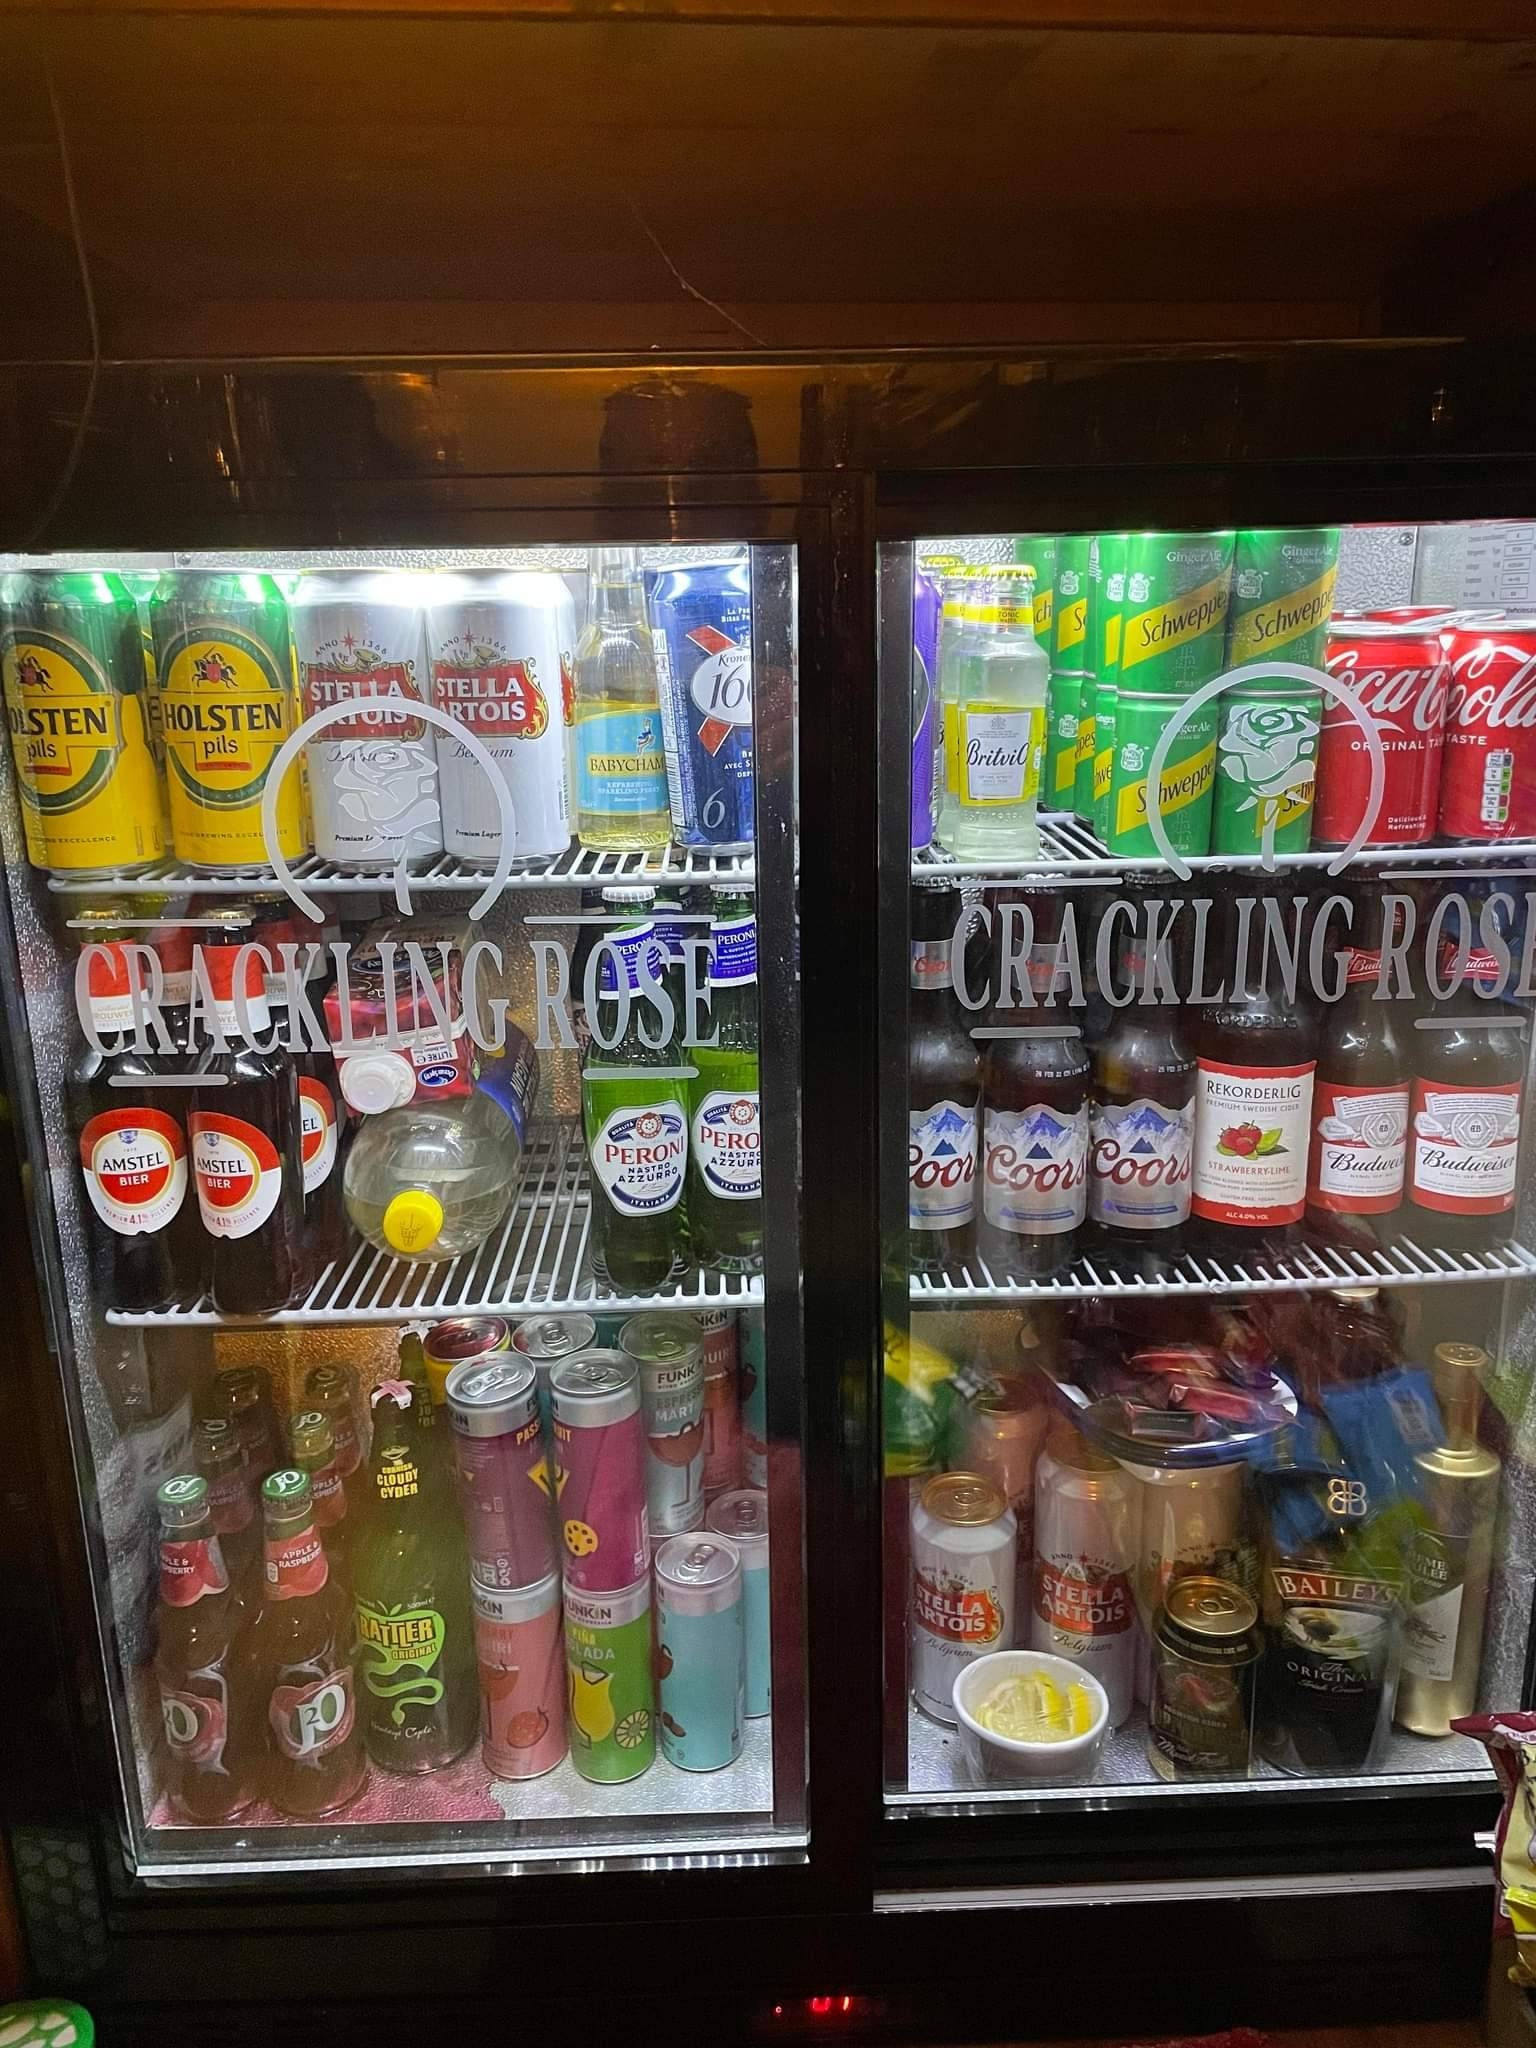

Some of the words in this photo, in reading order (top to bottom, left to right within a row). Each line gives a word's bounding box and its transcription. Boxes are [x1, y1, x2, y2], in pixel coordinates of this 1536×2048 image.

[1166, 551, 1206, 564] Ginger
[1208, 550, 1223, 562] Ale
[1281, 545, 1318, 558] Ginger
[315, 639, 338, 657] ANNO
[310, 679, 405, 702] STELLA
[436, 677, 525, 698] STELLA
[710, 663, 752, 710] 16
[163, 702, 282, 732] HOLSTEN
[1198, 721, 1211, 732] Ale
[203, 735, 239, 761] pils
[1350, 740, 1425, 752] ORGINAL
[1446, 733, 1488, 746] TASTE
[28, 737, 58, 763] pils
[589, 756, 664, 773] BABYCHAM
[724, 761, 743, 770] AVEC
[702, 787, 726, 830] 6
[334, 834, 364, 842] Premium
[950, 894, 1355, 1012] CRACKLING
[1373, 892, 1536, 1005] ROSE
[75, 940, 511, 1057] CRACKLING
[529, 937, 721, 1052] ROSE
[1207, 1079, 1301, 1099] REKORDERLIG
[1206, 1098, 1241, 1111] PREMIUM
[1243, 1104, 1277, 1113] SWEDISH
[1280, 1103, 1300, 1113] CIDER
[605, 1135, 684, 1165] PERONI
[1419, 1145, 1515, 1171] Budweiser
[102, 1151, 165, 1172] AMSTEL
[197, 1157, 247, 1174] AMSTEL
[628, 1162, 671, 1174] NASTRO
[986, 1139, 1086, 1193] Coors
[1091, 1135, 1192, 1188] Coors
[119, 1174, 150, 1187] BIER
[207, 1177, 232, 1189] BIER
[618, 1166, 678, 1183] AZZURRO
[630, 1193, 670, 1208] ITALIANA
[1225, 1211, 1238, 1220] ALC
[1256, 1212, 1269, 1222] VOL
[657, 1361, 704, 1385] FUNK
[376, 1468, 419, 1487] CLOUDY
[380, 1482, 419, 1500] CYDER
[278, 1546, 322, 1570] RASPBERRY
[282, 1544, 312, 1560] APPLE
[181, 1558, 189, 1567] &
[1042, 1574, 1125, 1606] STELLA
[1279, 1575, 1394, 1604] BAILEYS
[916, 1583, 985, 1617] STELLA
[1041, 1593, 1126, 1624] ARTOIS
[914, 1600, 987, 1633] ARTOIS
[360, 1616, 434, 1650] RATTLER
[1053, 1630, 1113, 1656] Belgium
[391, 1645, 437, 1661] ORIGINAL
[926, 1637, 974, 1657] Belgium
[1286, 1661, 1378, 1683] ORIGINAL
